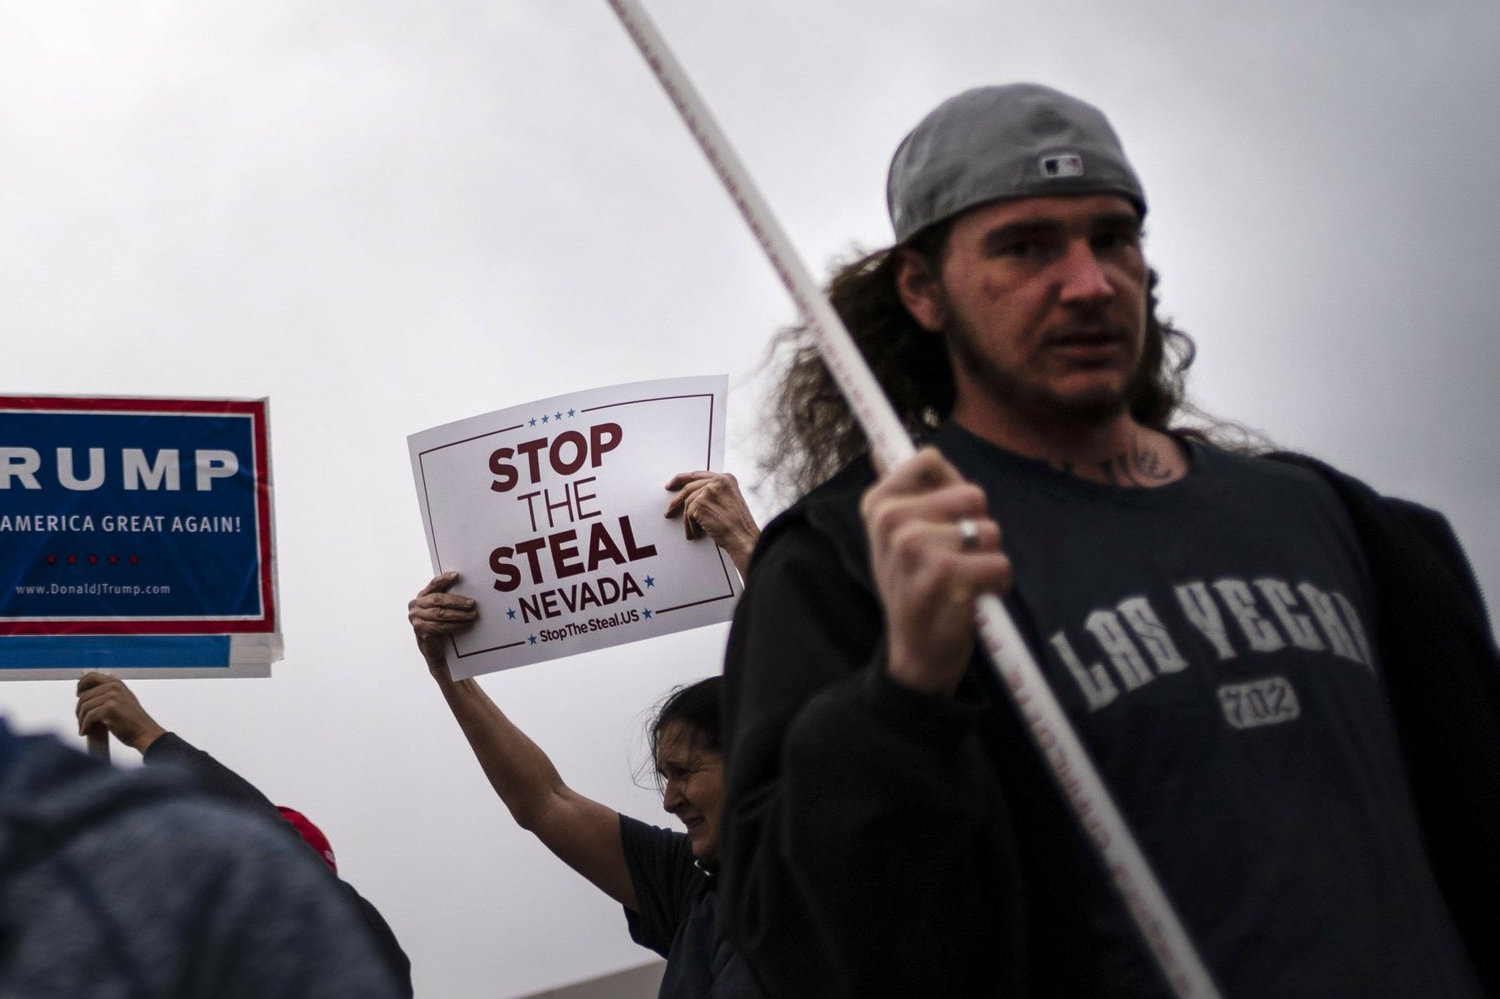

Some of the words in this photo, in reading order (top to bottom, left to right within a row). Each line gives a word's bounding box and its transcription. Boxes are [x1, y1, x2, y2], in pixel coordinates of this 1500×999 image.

[488, 422, 623, 493] STOP
[0, 514, 95, 533] AMERICA
[101, 515, 165, 534] GREAT
[171, 516, 241, 534] AGAIN!
[517, 476, 602, 532] THE
[488, 515, 658, 593] STEAL
[15, 582, 171, 597] www.DonaldJTrump.com
[518, 572, 645, 624] NEVADA
[1049, 597, 1190, 713] LAS
[1222, 682, 1294, 724] 702
